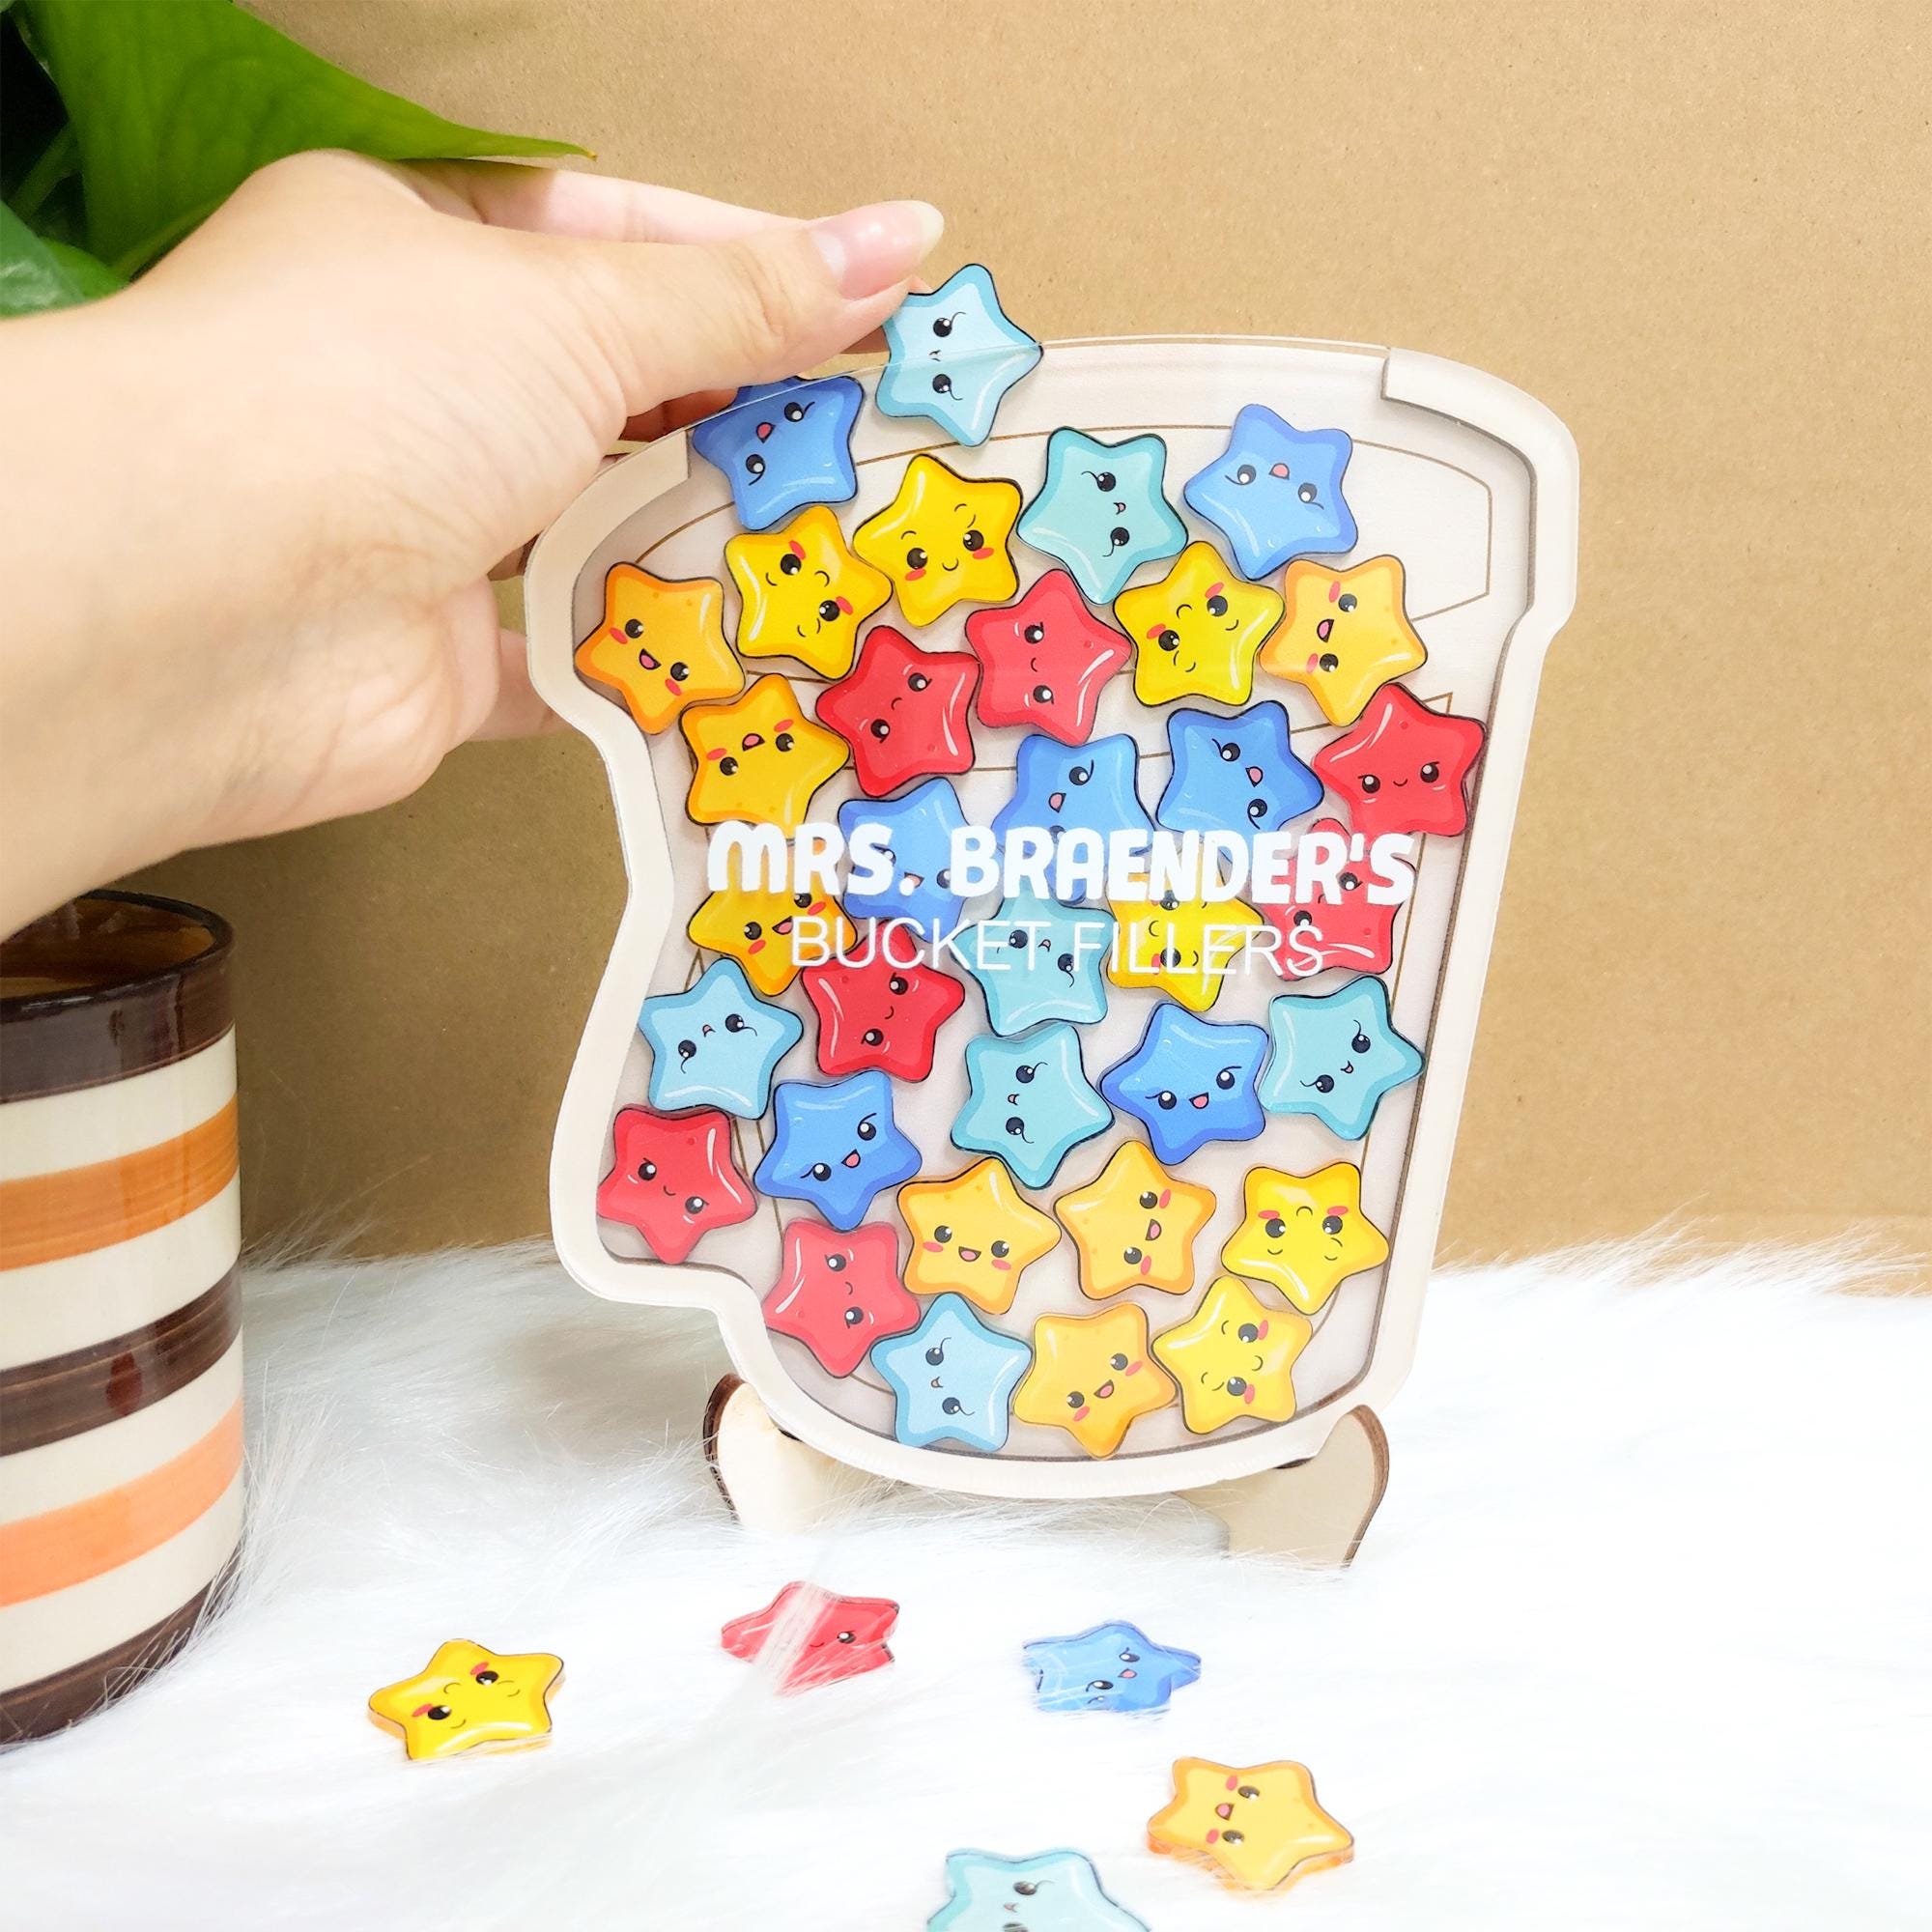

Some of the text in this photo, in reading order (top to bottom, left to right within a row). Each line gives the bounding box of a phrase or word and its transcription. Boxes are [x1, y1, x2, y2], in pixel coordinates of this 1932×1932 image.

[707, 820, 1415, 906] MRS. BRAENDER'S
[791, 916, 1323, 978] BUCKET FILLERS
